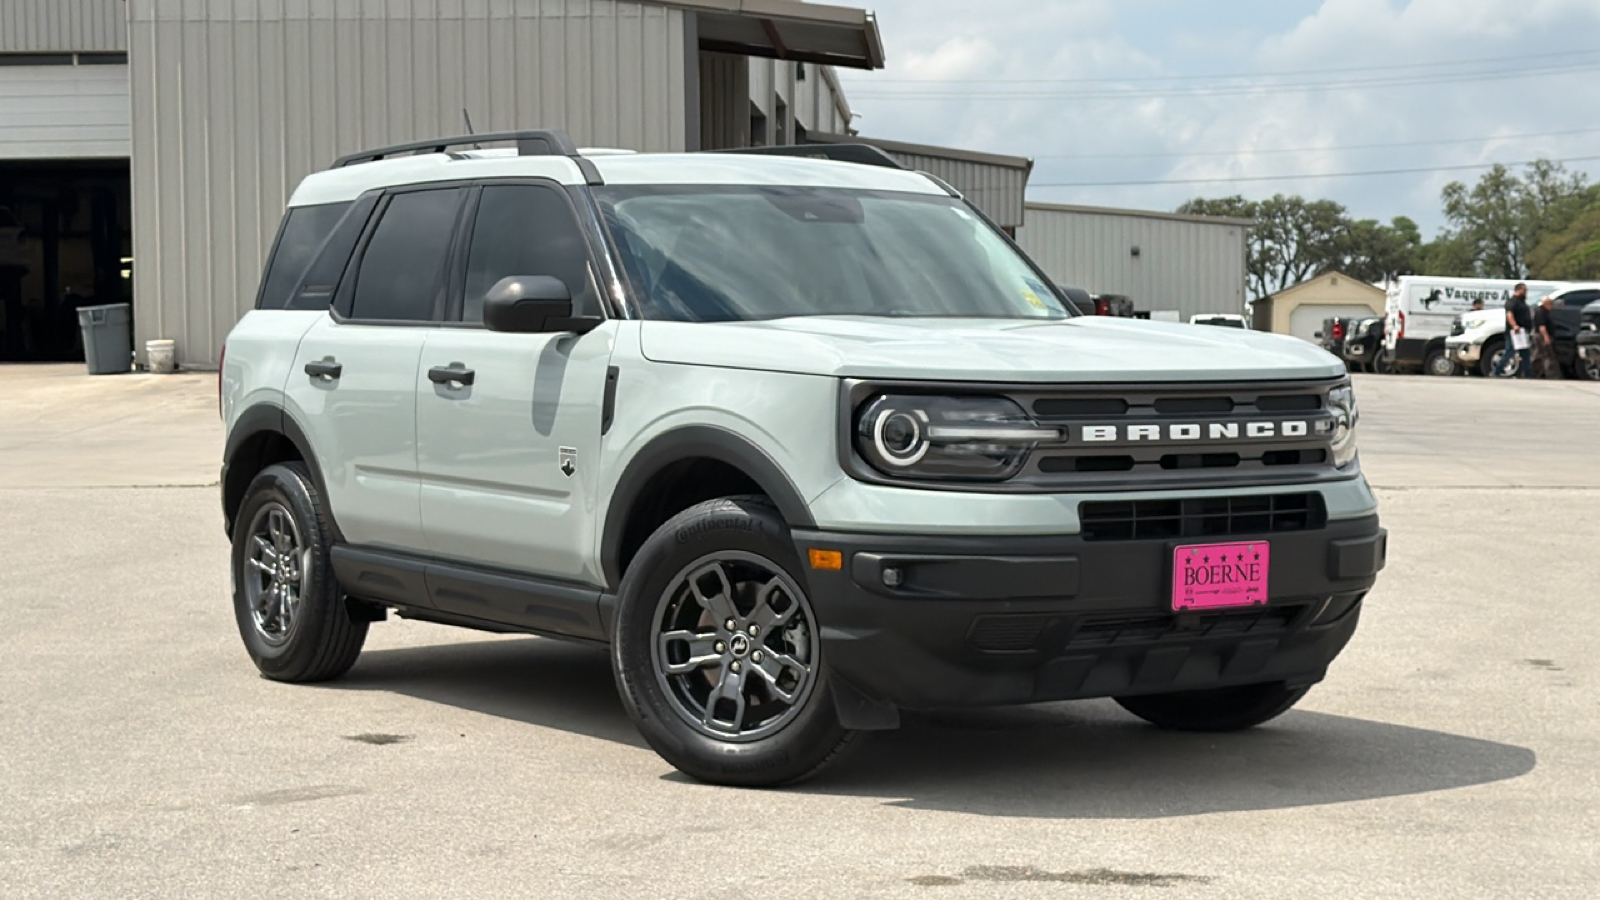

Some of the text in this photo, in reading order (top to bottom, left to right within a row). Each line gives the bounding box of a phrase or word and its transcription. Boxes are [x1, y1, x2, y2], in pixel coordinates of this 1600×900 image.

[1445, 286, 1499, 301] Vaquero
[1082, 421, 1307, 441] BRONCO
[1184, 564, 1260, 586] BOERNE
